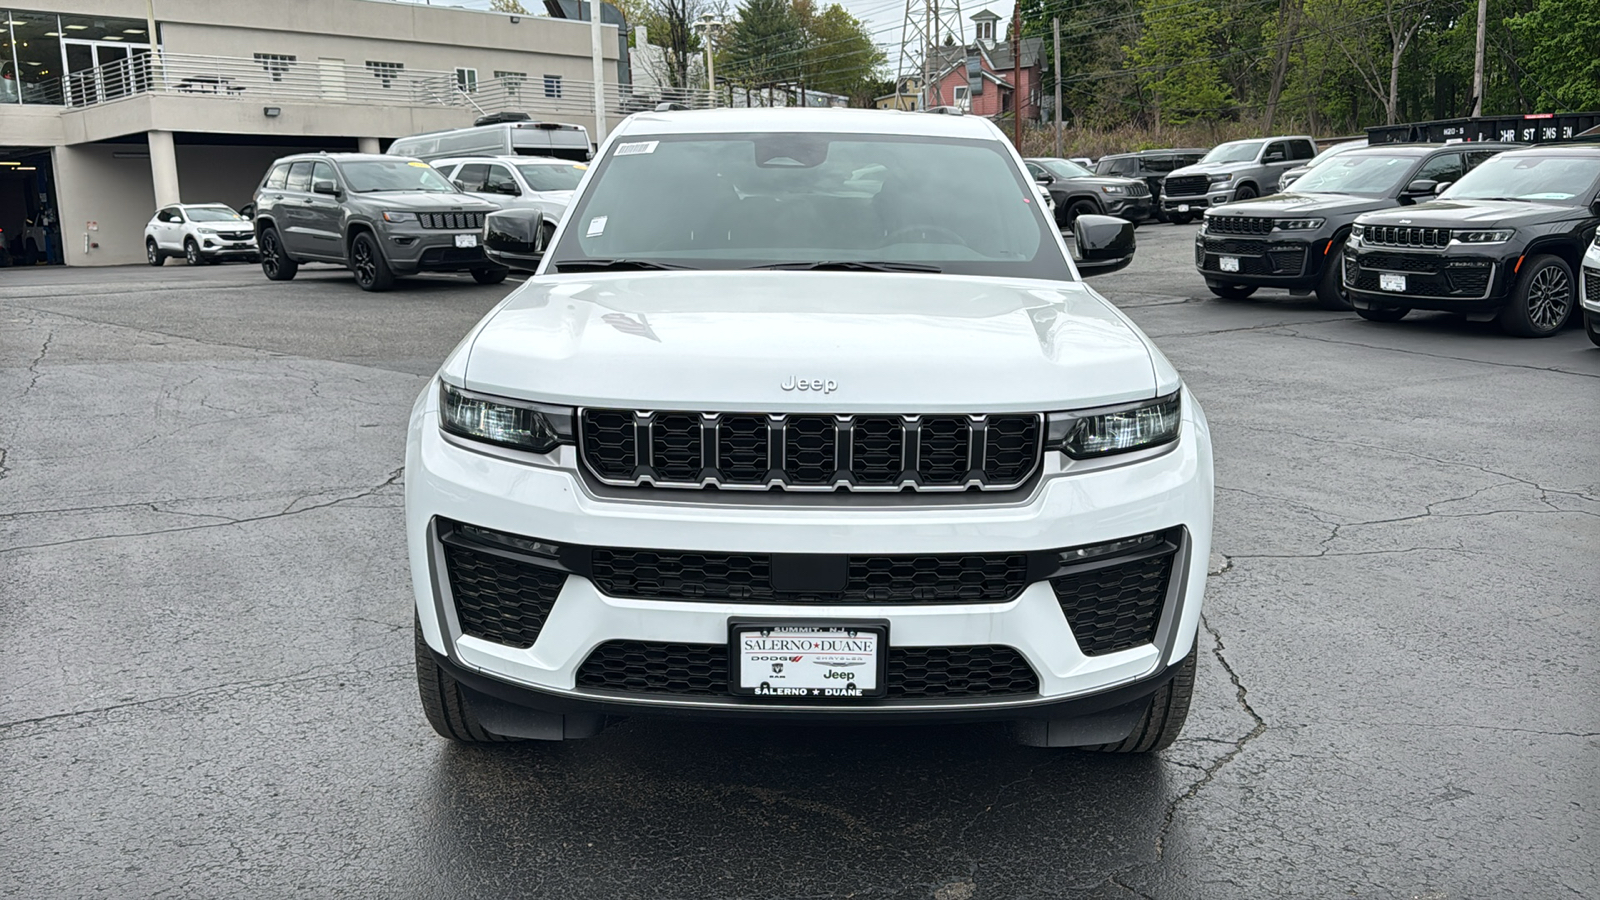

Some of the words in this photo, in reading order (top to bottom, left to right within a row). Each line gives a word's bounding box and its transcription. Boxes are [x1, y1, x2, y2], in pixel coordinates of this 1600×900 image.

[781, 375, 838, 394] Jeep
[744, 640, 812, 651] SALERNO
[821, 641, 873, 652] DUANE
[823, 670, 855, 681] Jeep
[754, 688, 807, 696] SALERNO
[825, 688, 862, 697] DUANE
